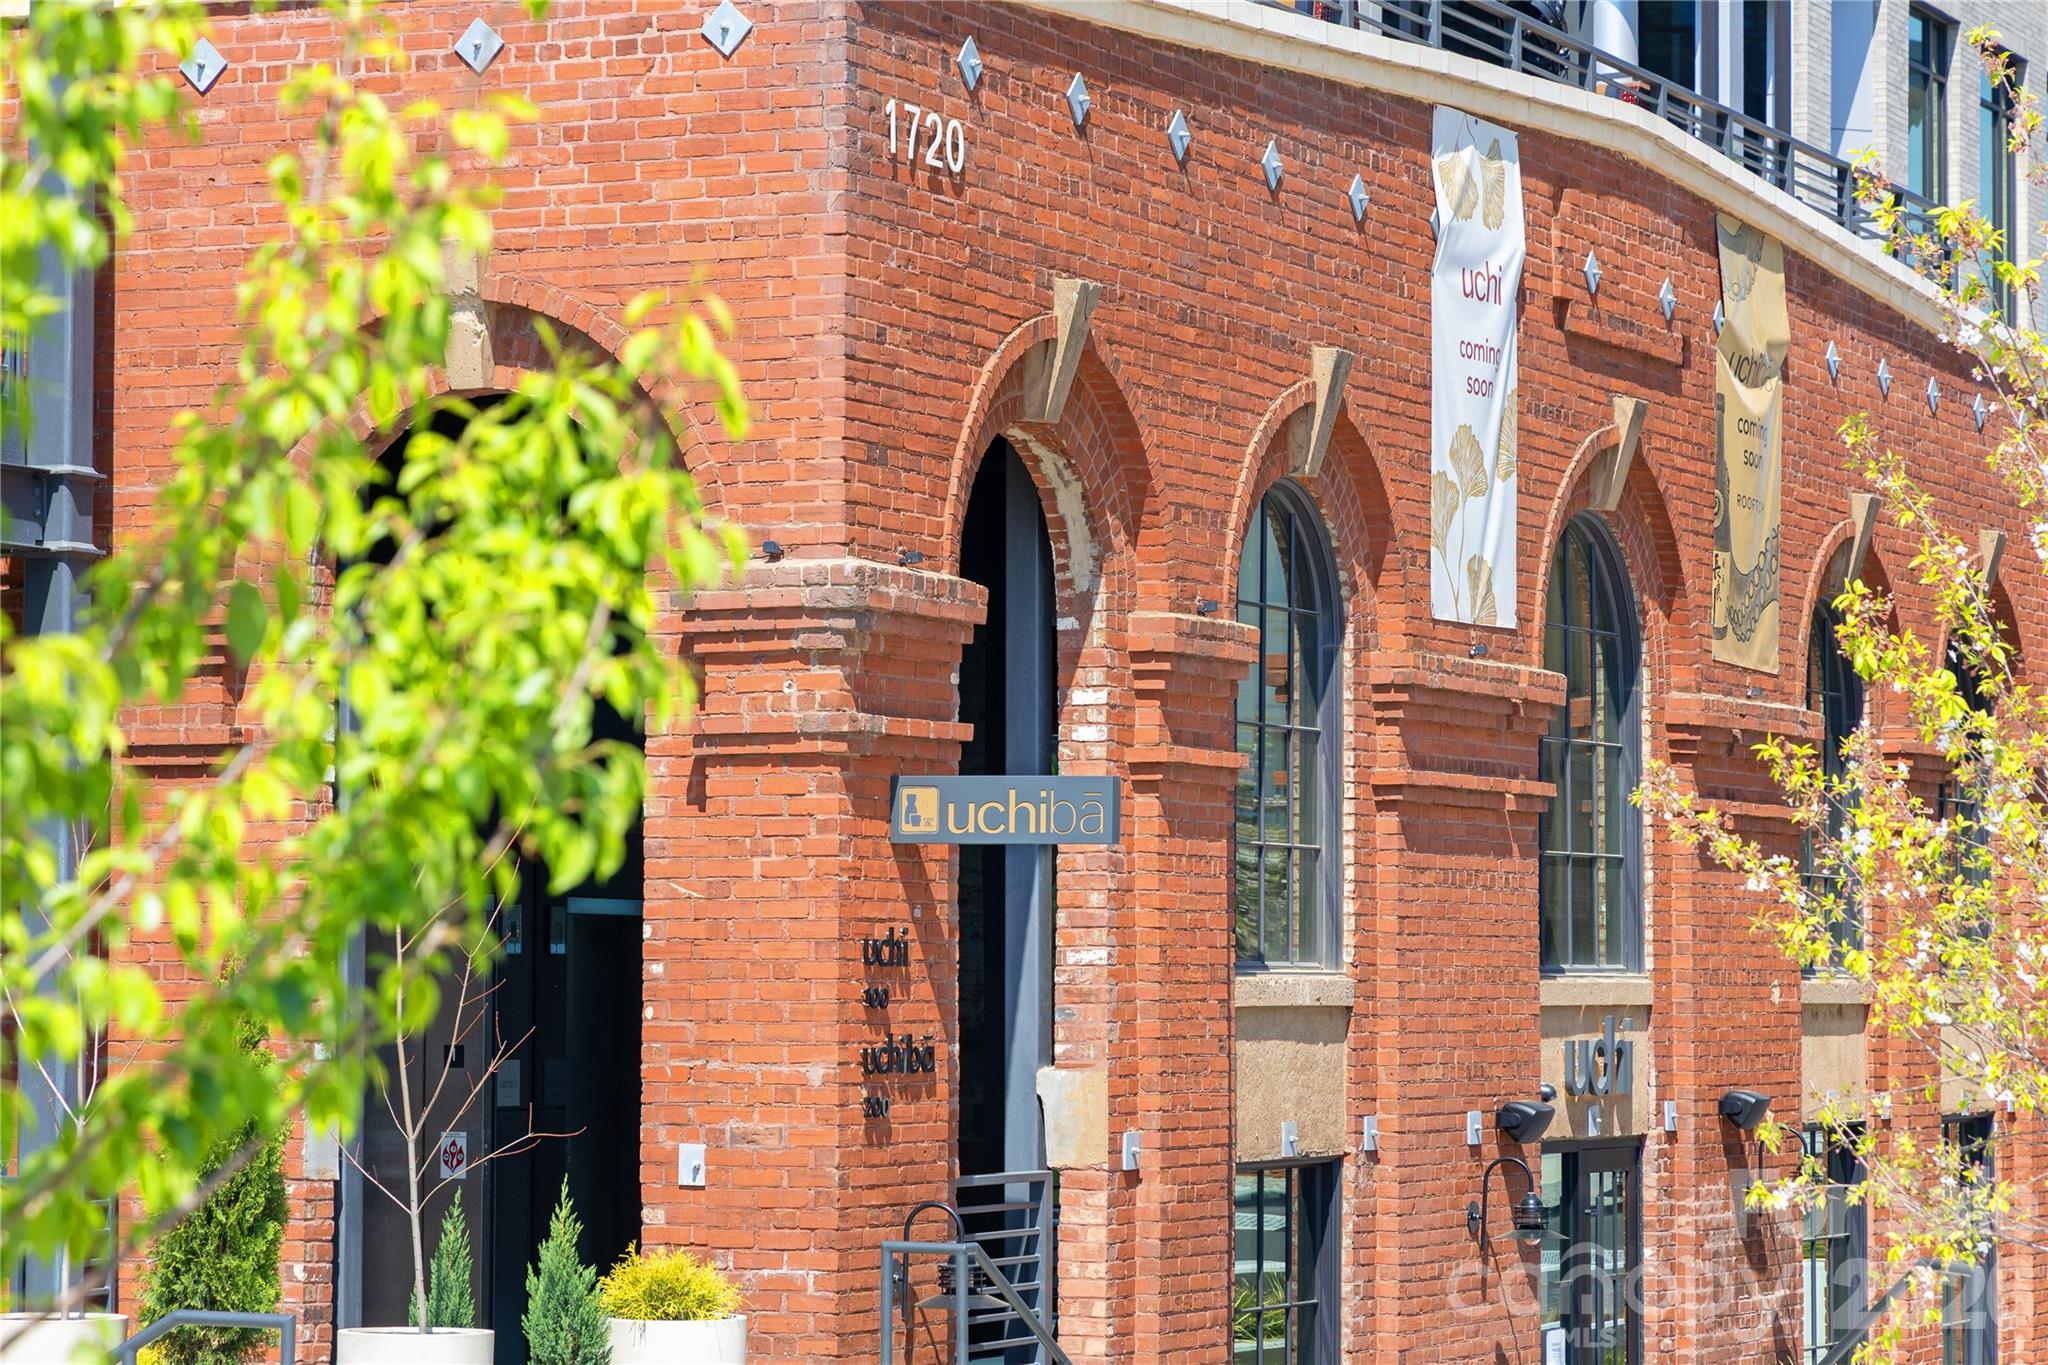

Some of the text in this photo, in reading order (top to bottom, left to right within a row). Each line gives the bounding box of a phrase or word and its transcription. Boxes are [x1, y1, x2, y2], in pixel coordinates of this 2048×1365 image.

[885, 98, 964, 173] 1720
[1461, 260, 1502, 306] uchi
[1459, 338, 1501, 373] coming
[1466, 376, 1494, 399] soon
[1737, 417, 1768, 449] coming
[1743, 449, 1764, 472] soon
[947, 788, 1105, 836] uchibā
[863, 926, 910, 968] uchi
